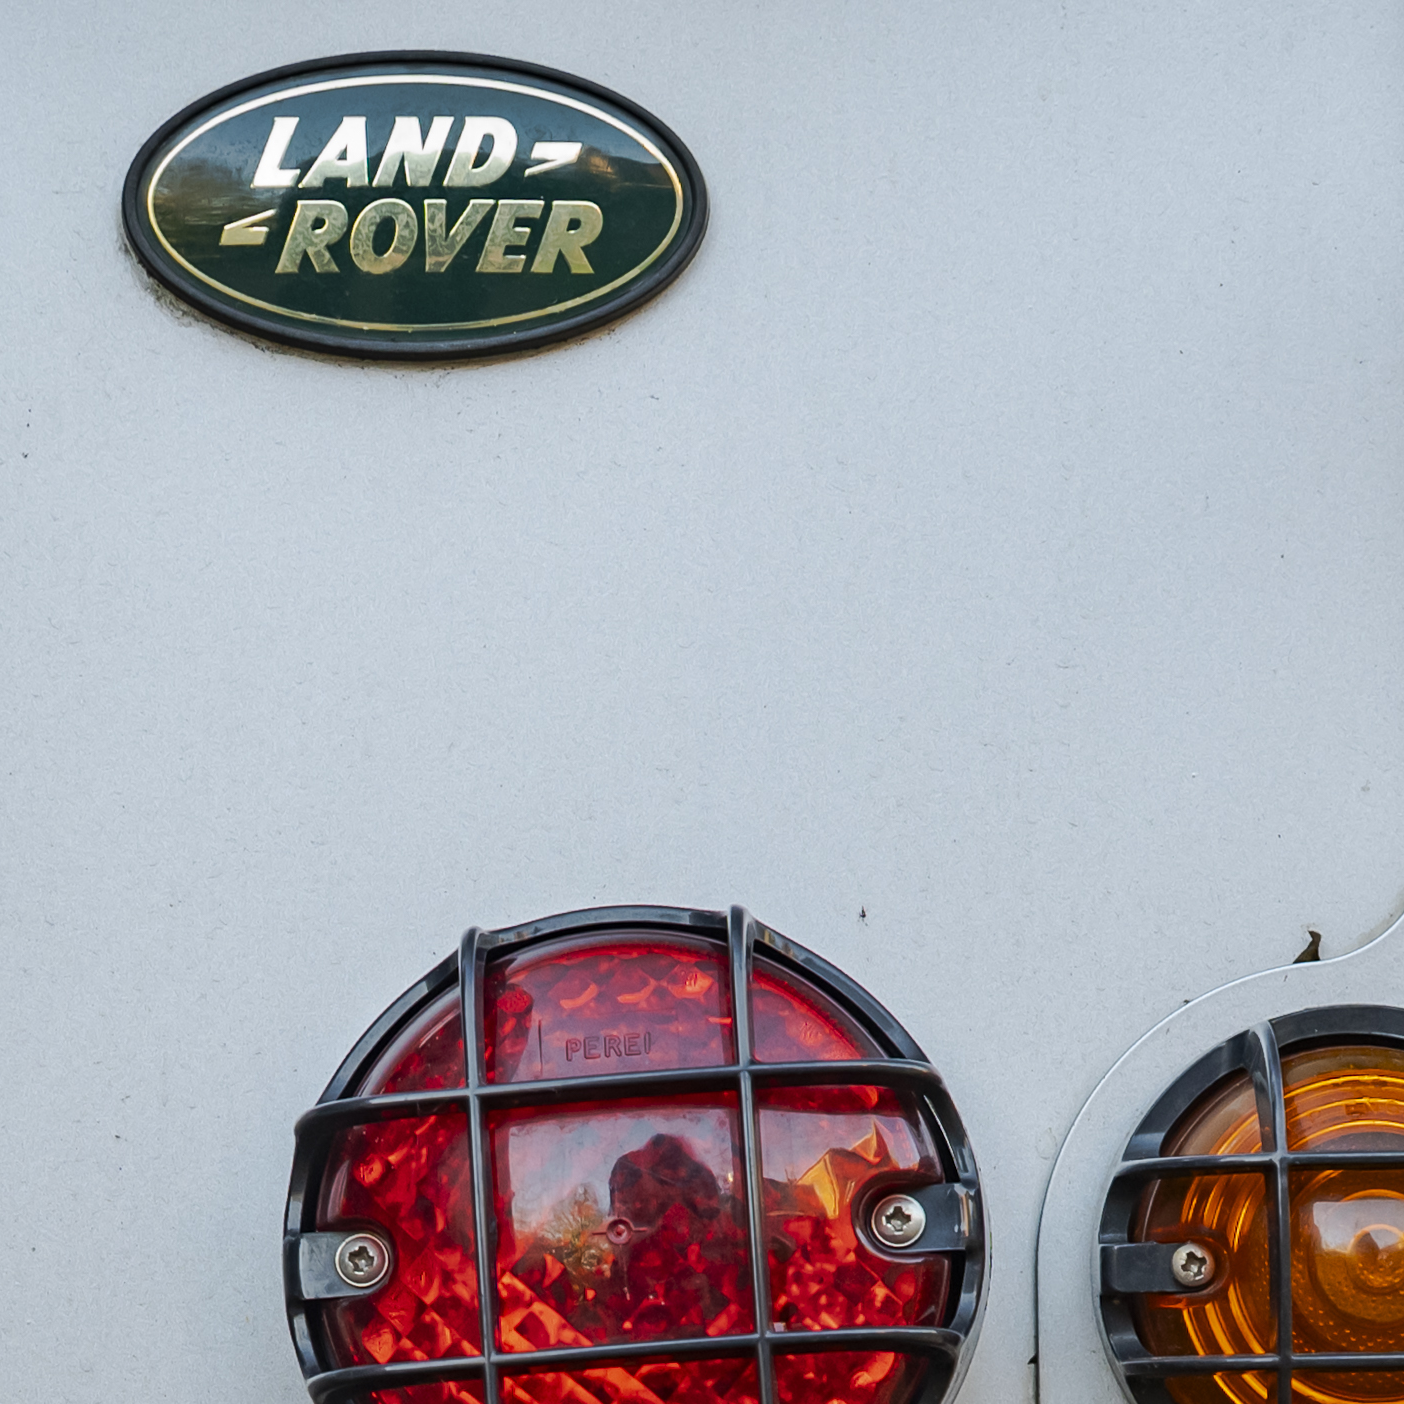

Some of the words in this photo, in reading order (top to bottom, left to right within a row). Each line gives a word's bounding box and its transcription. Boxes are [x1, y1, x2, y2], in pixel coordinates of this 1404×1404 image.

[249, 115, 519, 189] LAND
[274, 197, 604, 275] ROVER
[564, 1031, 652, 1062] PEREI
